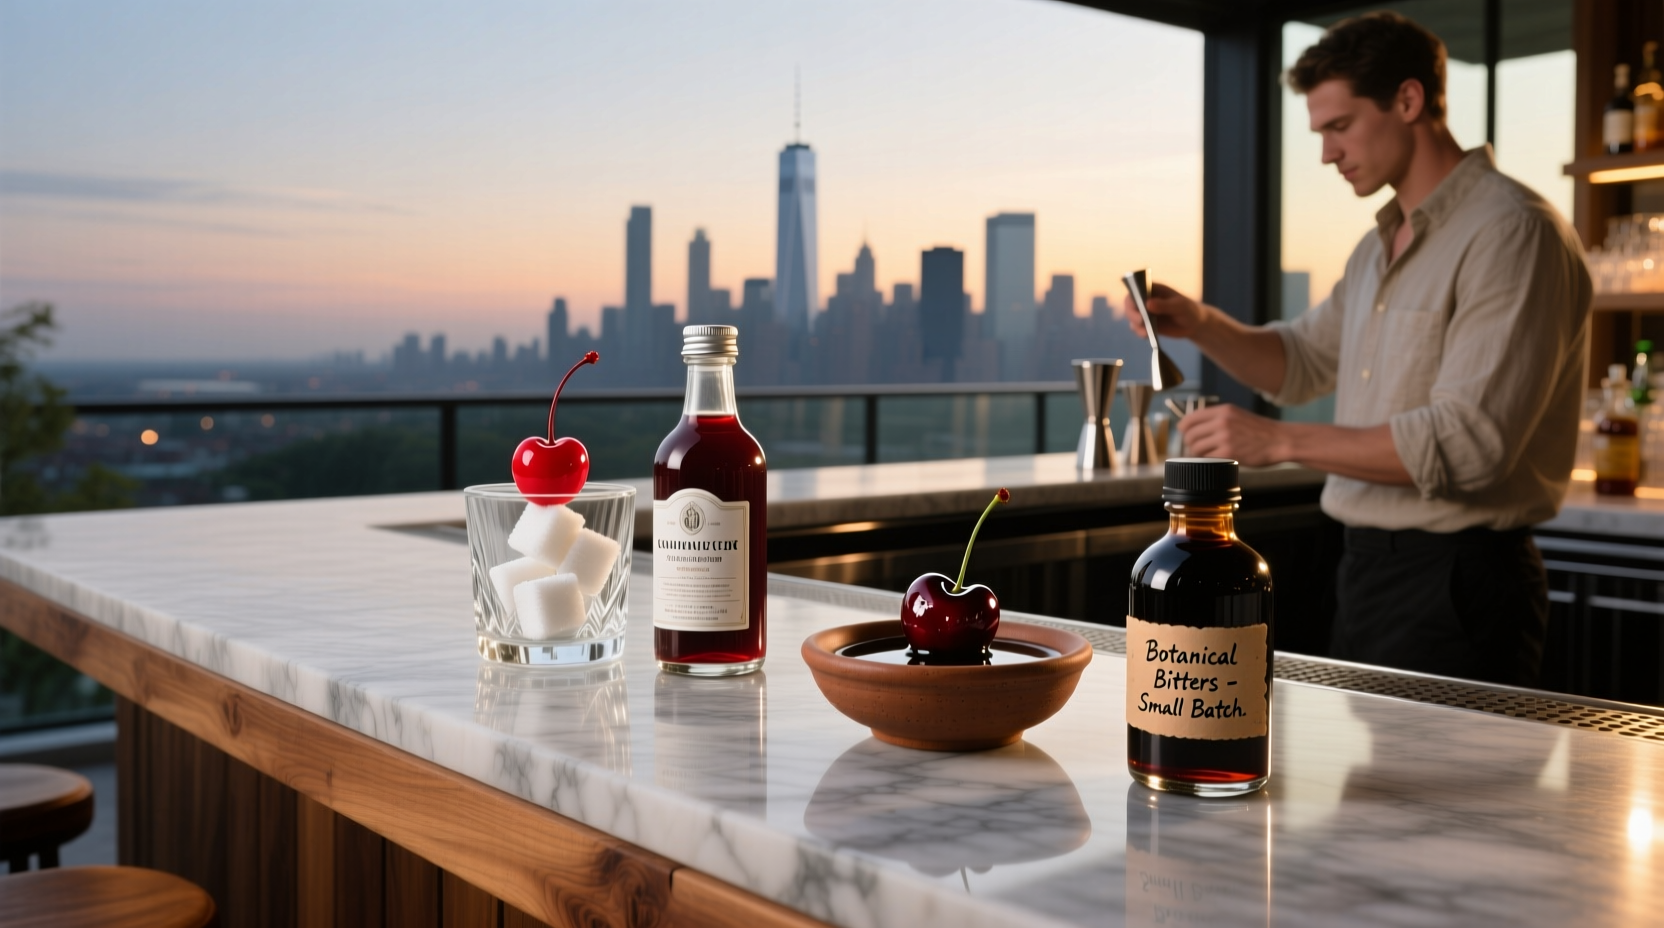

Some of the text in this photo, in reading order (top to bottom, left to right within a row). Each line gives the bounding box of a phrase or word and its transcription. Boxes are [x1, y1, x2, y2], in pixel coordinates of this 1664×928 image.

[1146, 639, 1238, 665] Botanical
[1153, 668, 1219, 692] Bitters
[1137, 692, 1247, 719] Small Batch.
